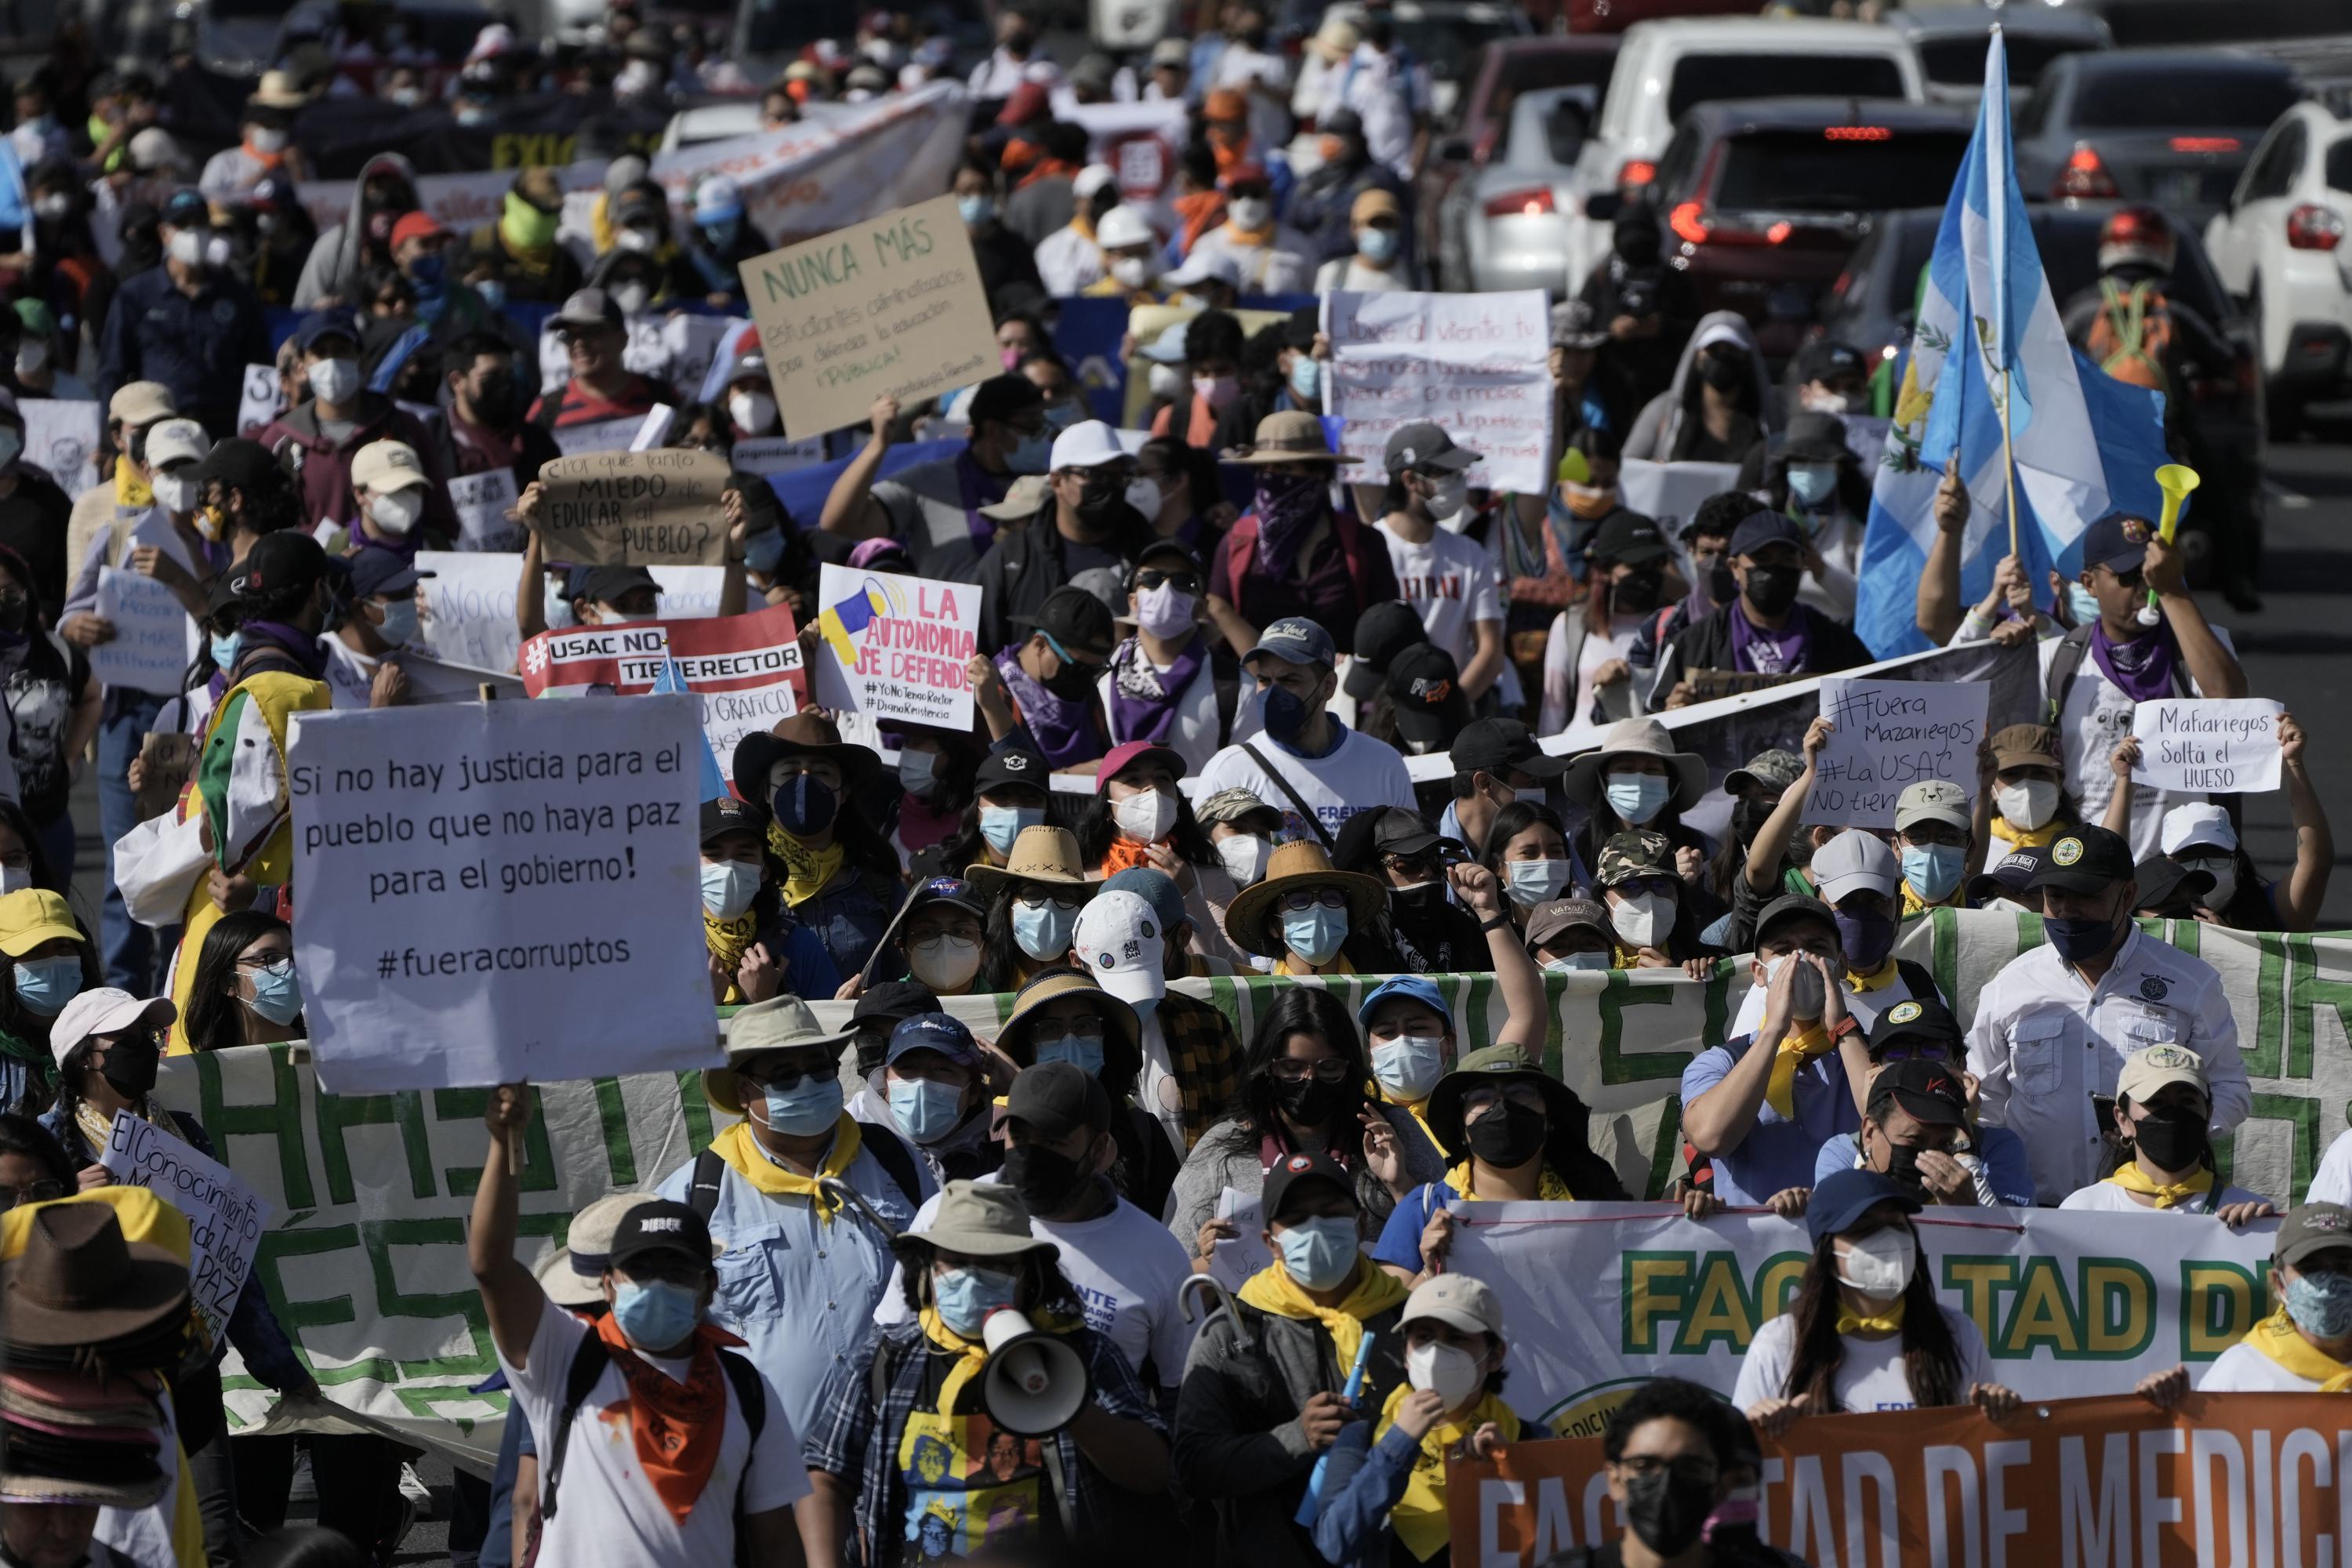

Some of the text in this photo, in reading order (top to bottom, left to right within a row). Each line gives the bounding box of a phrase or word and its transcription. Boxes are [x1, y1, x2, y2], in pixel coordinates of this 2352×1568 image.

[762, 218, 934, 303] NUNCA MÁS
[548, 458, 588, 478] ¿Por
[646, 453, 695, 470] tanto
[578, 474, 702, 499] MIEDO de
[552, 501, 652, 530] EDUCAR al
[622, 522, 710, 557] PUEBLO?
[919, 586, 959, 622] LA
[623, 632, 662, 652] NO
[866, 615, 976, 661] AUTONOMIA
[622, 648, 797, 680] TIEE RECTOR
[854, 646, 973, 692] SE DEFIENDE
[1825, 689, 1926, 734] #Fuera
[2160, 706, 2269, 742] Mafiariegos
[1865, 719, 1974, 757] Mazariegos
[2216, 740, 2229, 764] el
[293, 766, 321, 795] Si
[335, 766, 374, 793] no
[389, 758, 444, 793] hay
[458, 751, 564, 792] justicia
[577, 750, 644, 784] para
[655, 742, 681, 773] el
[1816, 750, 1952, 783] #La USAC
[2184, 768, 2234, 789] HUESO
[1810, 789, 1896, 811] NO tien
[306, 800, 681, 855] pueblo que no haya paz
[370, 847, 637, 903] para el gobierno!
[378, 935, 630, 979] #fueracorruptos
[111, 1113, 136, 1156] El
[133, 1127, 258, 1240] Conocimiento
[193, 1254, 238, 1317] PAZ
[1621, 1250, 2157, 1363] FACTAD
[1479, 1427, 2352, 1568] FACTAD DE MEDICI
